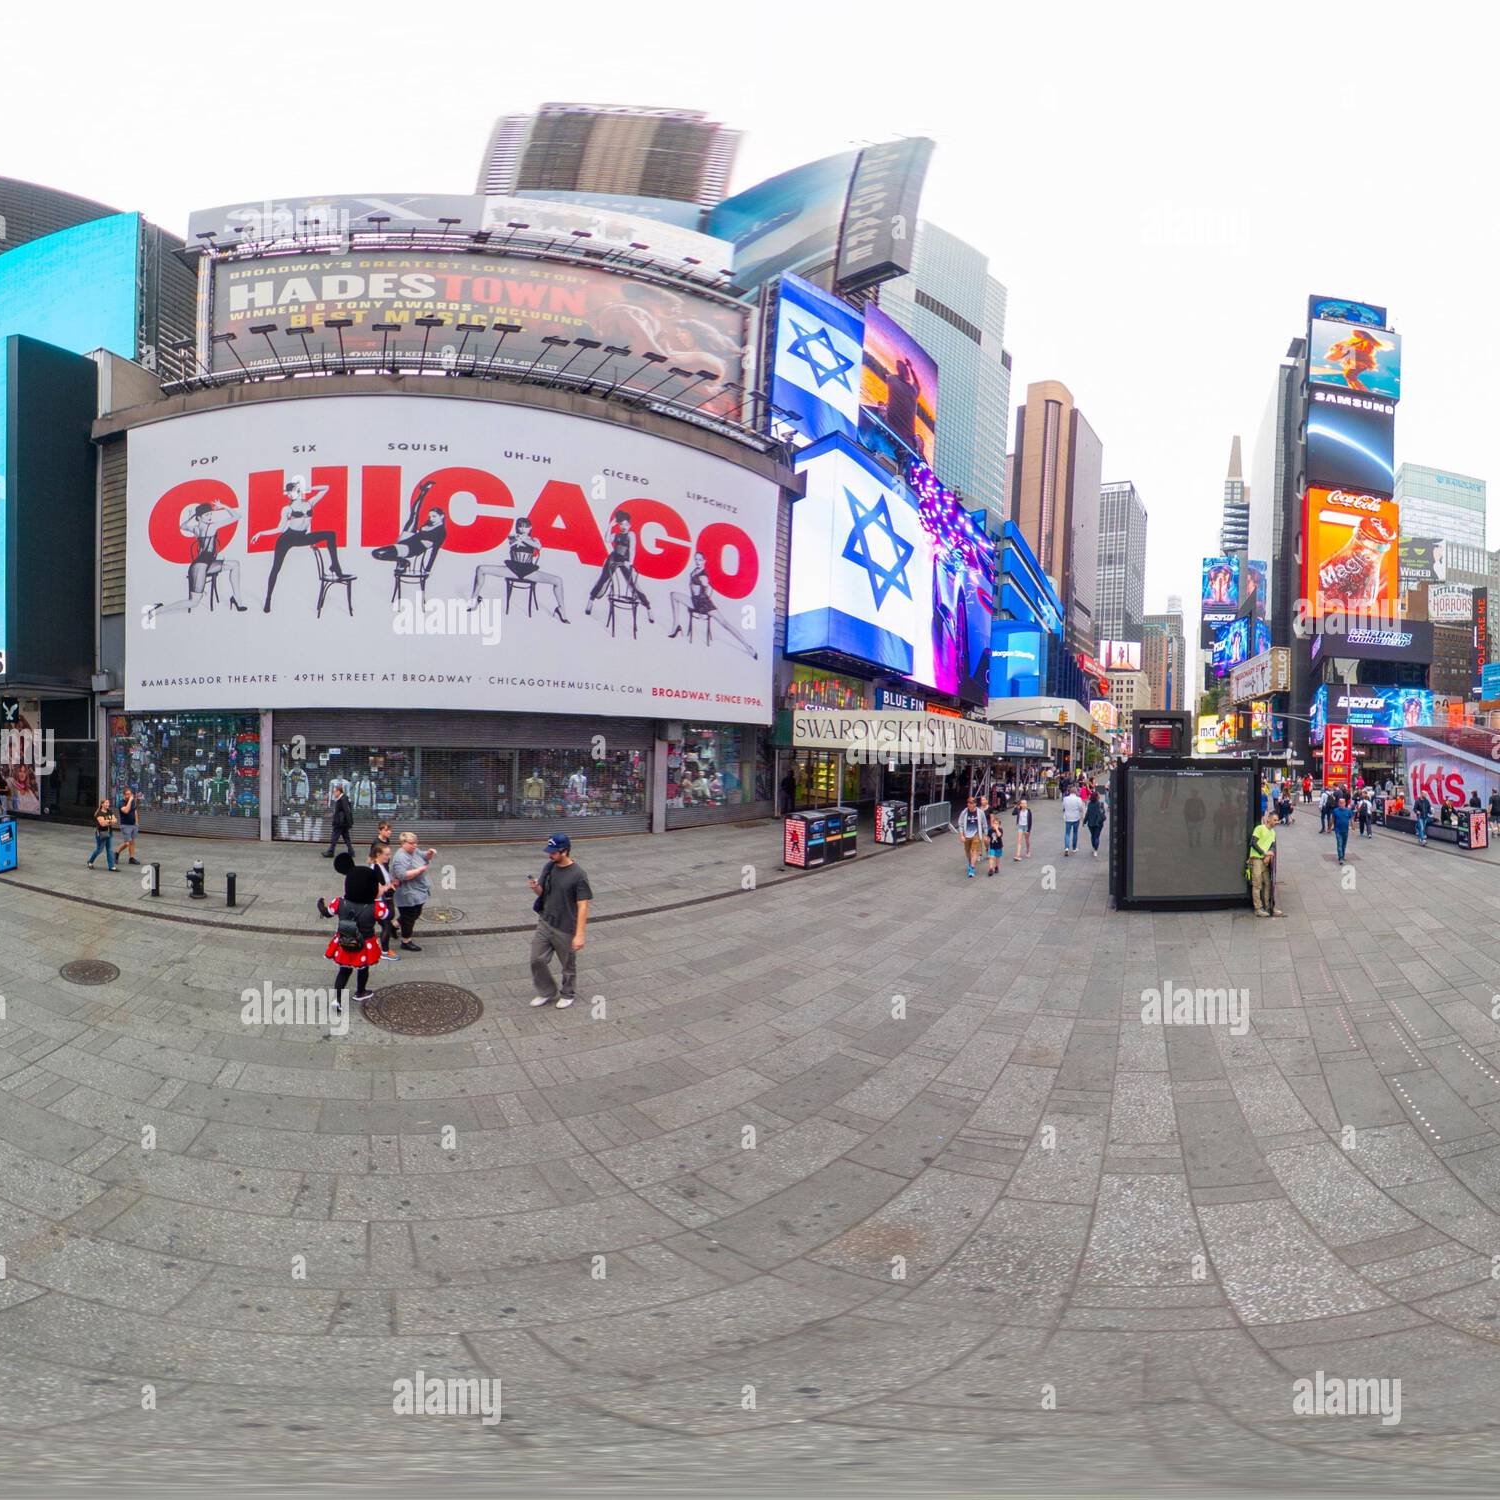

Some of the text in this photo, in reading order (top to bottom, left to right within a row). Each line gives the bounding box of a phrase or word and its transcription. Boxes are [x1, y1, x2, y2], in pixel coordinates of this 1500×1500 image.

[229, 260, 589, 284] BROADWAY'S GREATEST LOVE STORY
[229, 273, 588, 315] HADESTOWN
[229, 303, 306, 321] WINNER!
[334, 300, 383, 310] TONY
[290, 311, 369, 328] BEST
[1315, 392, 1394, 415] SAMSUNG
[292, 444, 317, 454] SIX
[387, 442, 449, 453] SQUISH
[503, 450, 552, 464] UH-UH
[190, 455, 219, 467] POP
[602, 467, 650, 486] CICERO
[686, 491, 738, 514] LIPSCHITZ
[148, 465, 759, 600] CHICAGO
[1433, 586, 1456, 597] LITTLE
[1433, 598, 1473, 616] HORRORS
[1477, 616, 1486, 638] LIKE
[148, 672, 643, 695] AMBASSADOR THEATRE 49TH STREET AT BROADWAY CHICAGOTHEMUSICAL.COM
[651, 687, 763, 707] BROADWAY. SINCE 1996.
[883, 690, 908, 708] BLUE
[910, 699, 925, 711] FIN
[795, 718, 992, 751] SWAROVSKI SWAROVSKI
[1331, 727, 1348, 762] tkts
[1410, 763, 1466, 808] tkts
